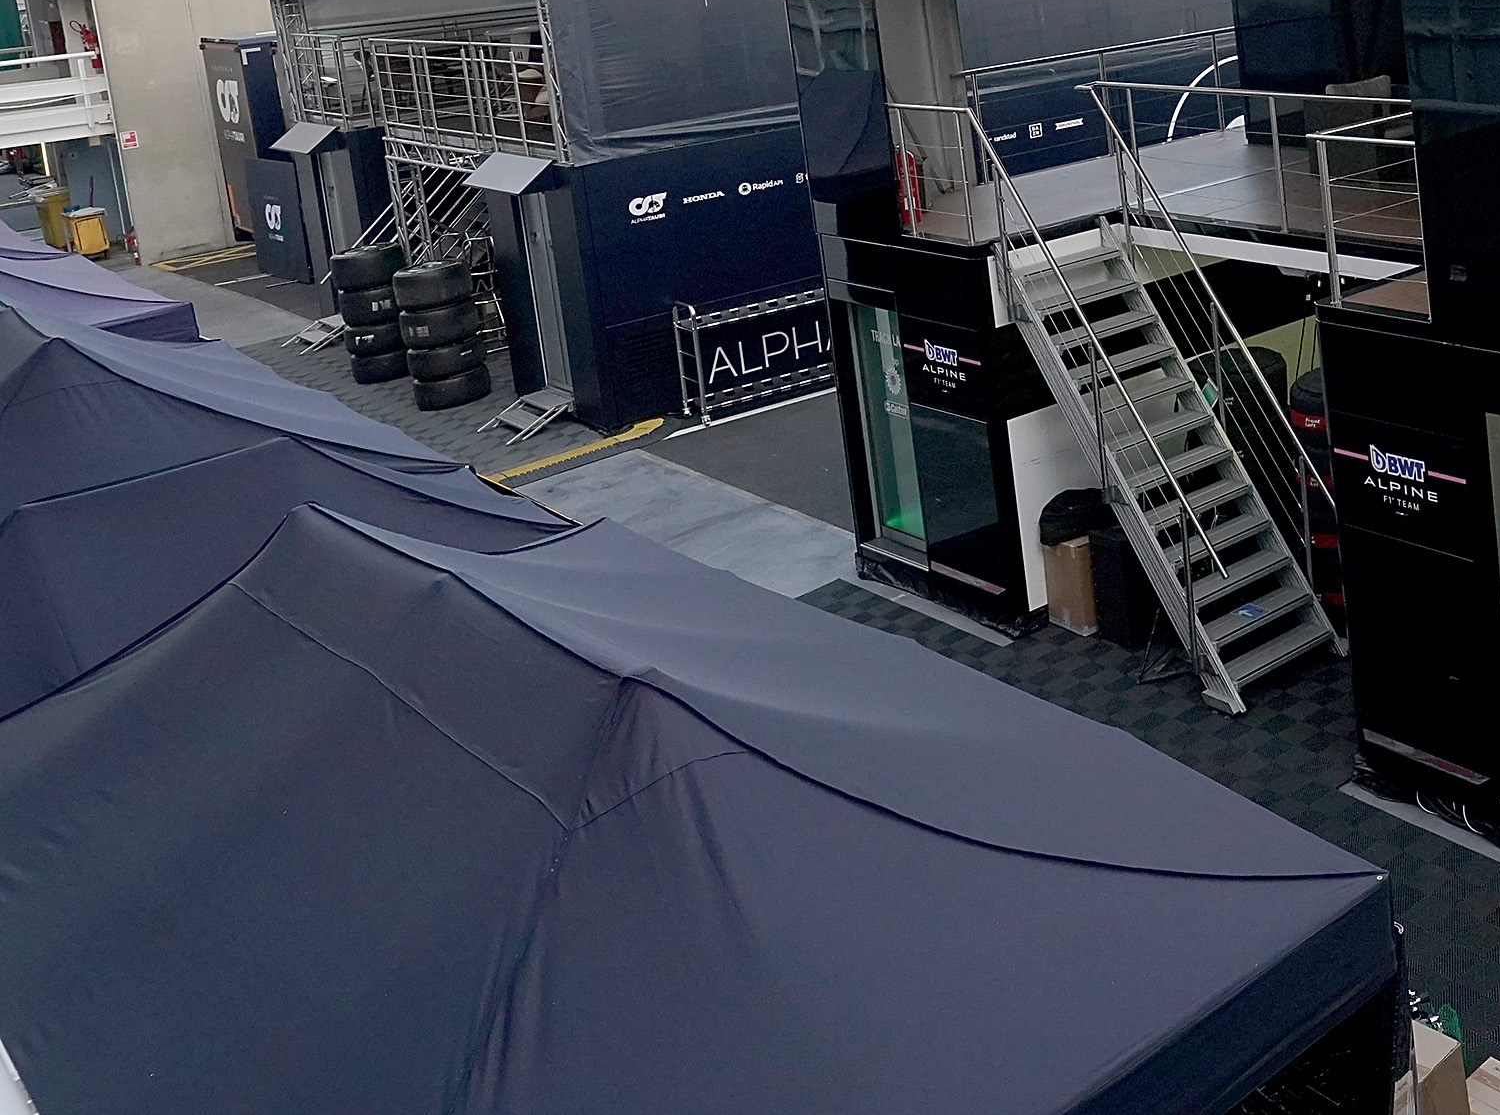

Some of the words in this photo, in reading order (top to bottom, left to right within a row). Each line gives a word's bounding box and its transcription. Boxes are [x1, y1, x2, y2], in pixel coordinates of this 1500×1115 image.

[682, 190, 725, 204] HONDA
[708, 320, 831, 385] ALPH
[933, 344, 958, 366] BWT
[922, 363, 967, 382] ALPINE
[1385, 452, 1426, 483] BWT
[1363, 475, 1439, 503] ALPINE
[1396, 498, 1420, 512] TEAM
